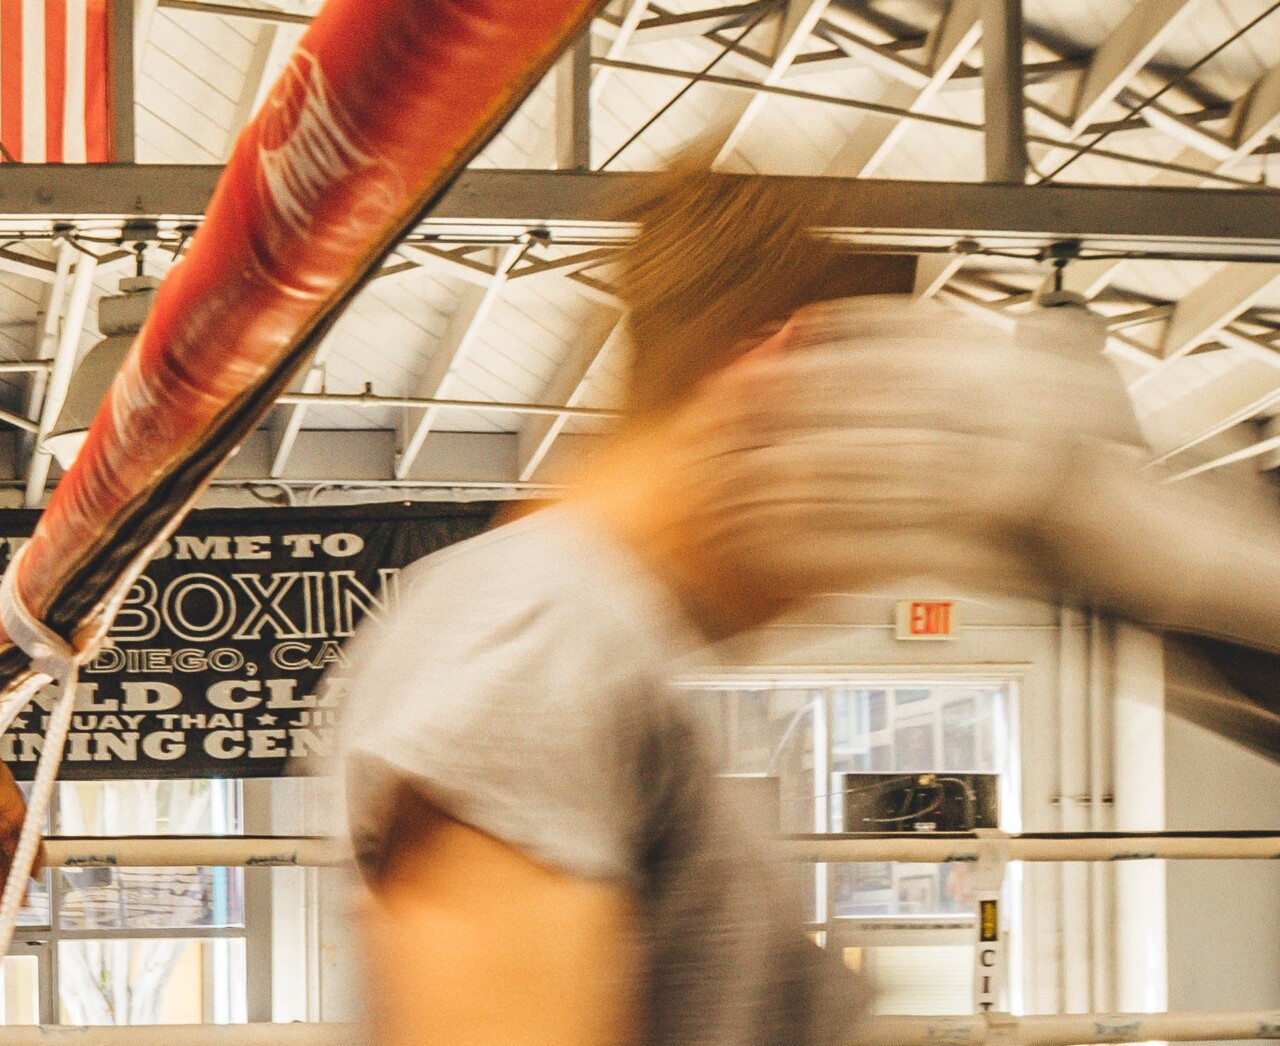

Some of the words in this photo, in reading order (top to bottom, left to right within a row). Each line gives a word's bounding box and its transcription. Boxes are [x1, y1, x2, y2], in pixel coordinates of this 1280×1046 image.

[283, 533, 365, 558] TO
[104, 568, 402, 643] BOXIN
[205, 678, 354, 711] CLA
[155, 713, 244, 730] THAI
[203, 728, 335, 761] CEN
[979, 949, 996, 1013] CIT
